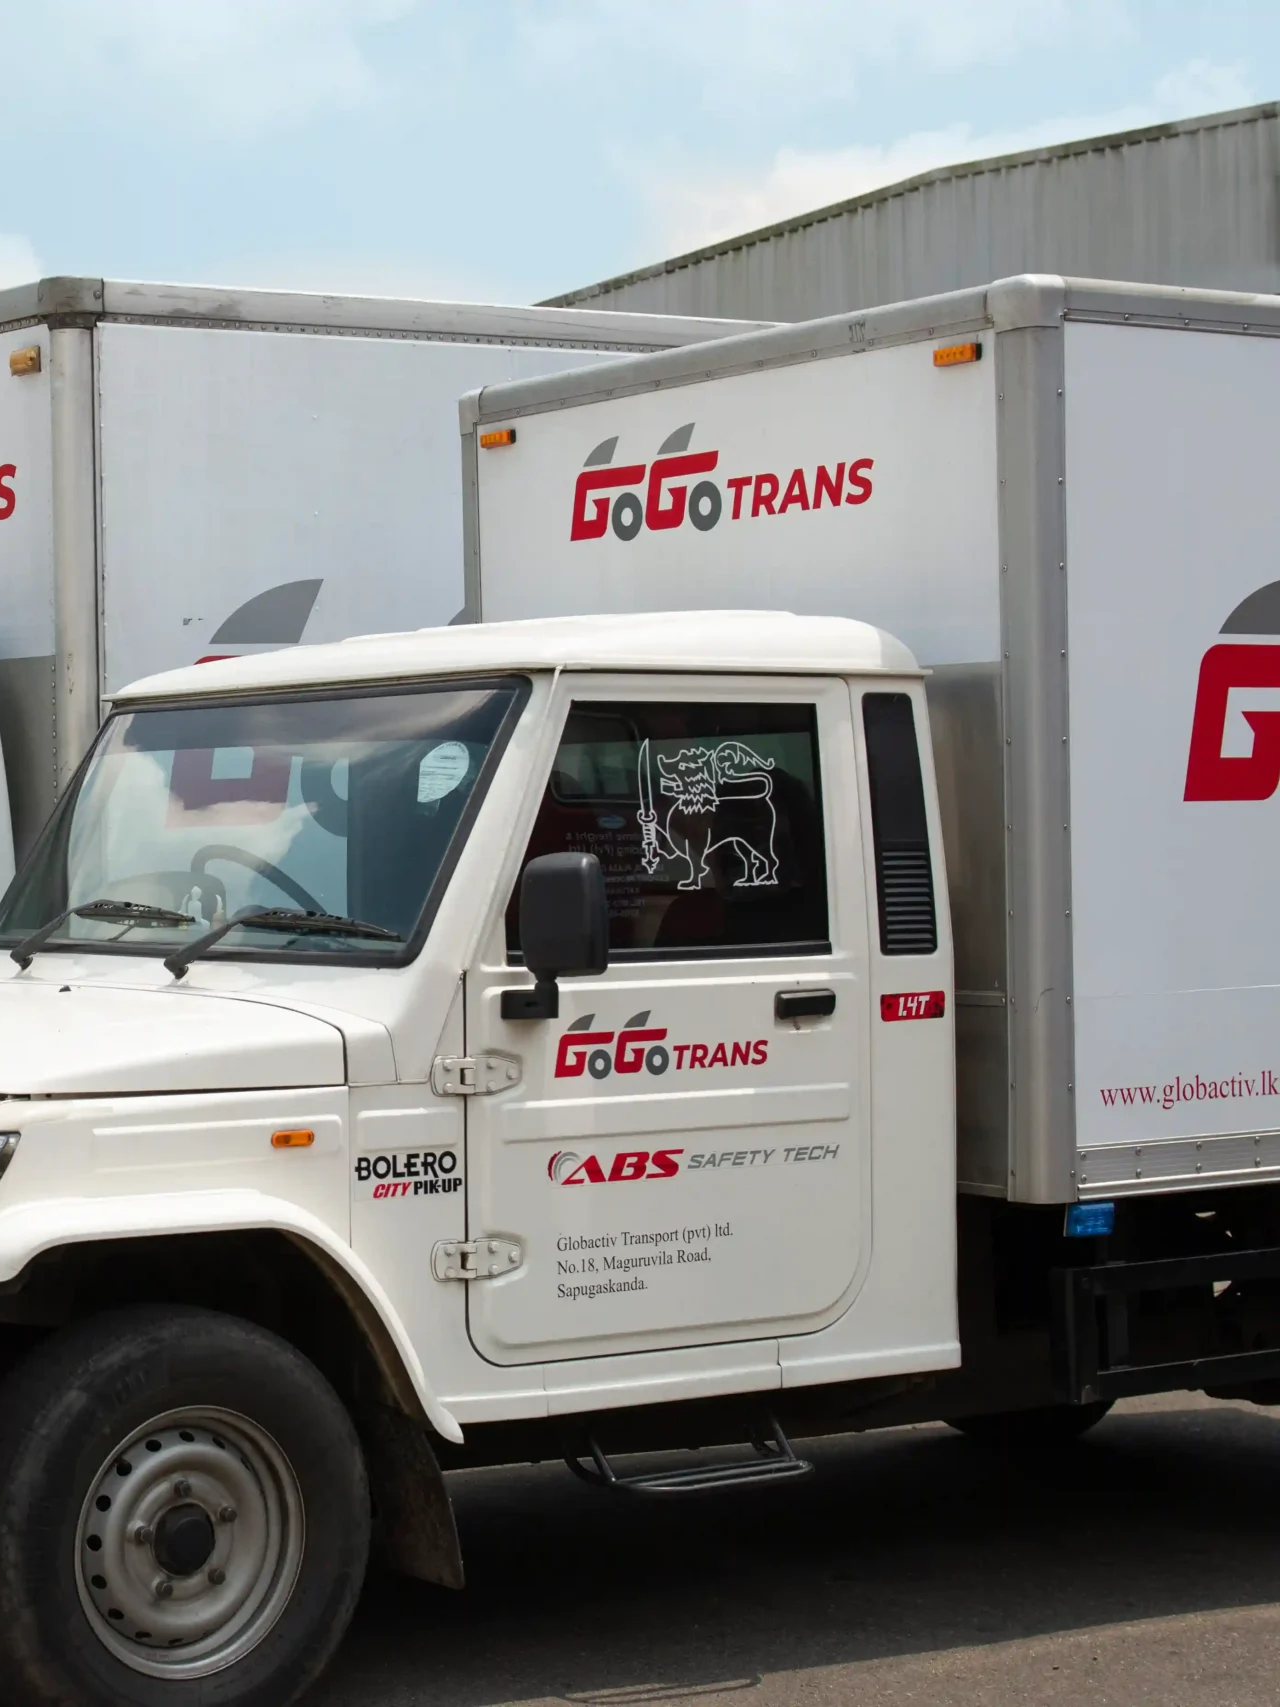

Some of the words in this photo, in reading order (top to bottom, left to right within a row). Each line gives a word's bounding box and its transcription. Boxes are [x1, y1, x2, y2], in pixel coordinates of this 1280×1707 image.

[570, 450, 722, 541] GoGo
[727, 458, 874, 520] TRANS
[898, 995, 930, 1017] 1.4T
[554, 1028, 669, 1079] GoGo
[672, 1040, 769, 1070] TRANS
[1100, 1070, 1280, 1110] www.globactiv.lk
[355, 1151, 457, 1181] BOLERO
[561, 1149, 684, 1185] ABS
[687, 1149, 776, 1169] SAFETY
[783, 1144, 839, 1162] TECH
[372, 1182, 412, 1199] CITY
[413, 1178, 462, 1195] PIK-UP
[557, 1233, 618, 1251] Globactiv
[621, 1229, 679, 1246] Transport
[682, 1224, 711, 1243] (pvt)
[715, 1222, 733, 1237] ltd.
[557, 1258, 599, 1275] No.18,
[603, 1251, 673, 1272] Maguruvila
[677, 1247, 712, 1264] Road,
[557, 1277, 648, 1300] Sapugaskanda.
